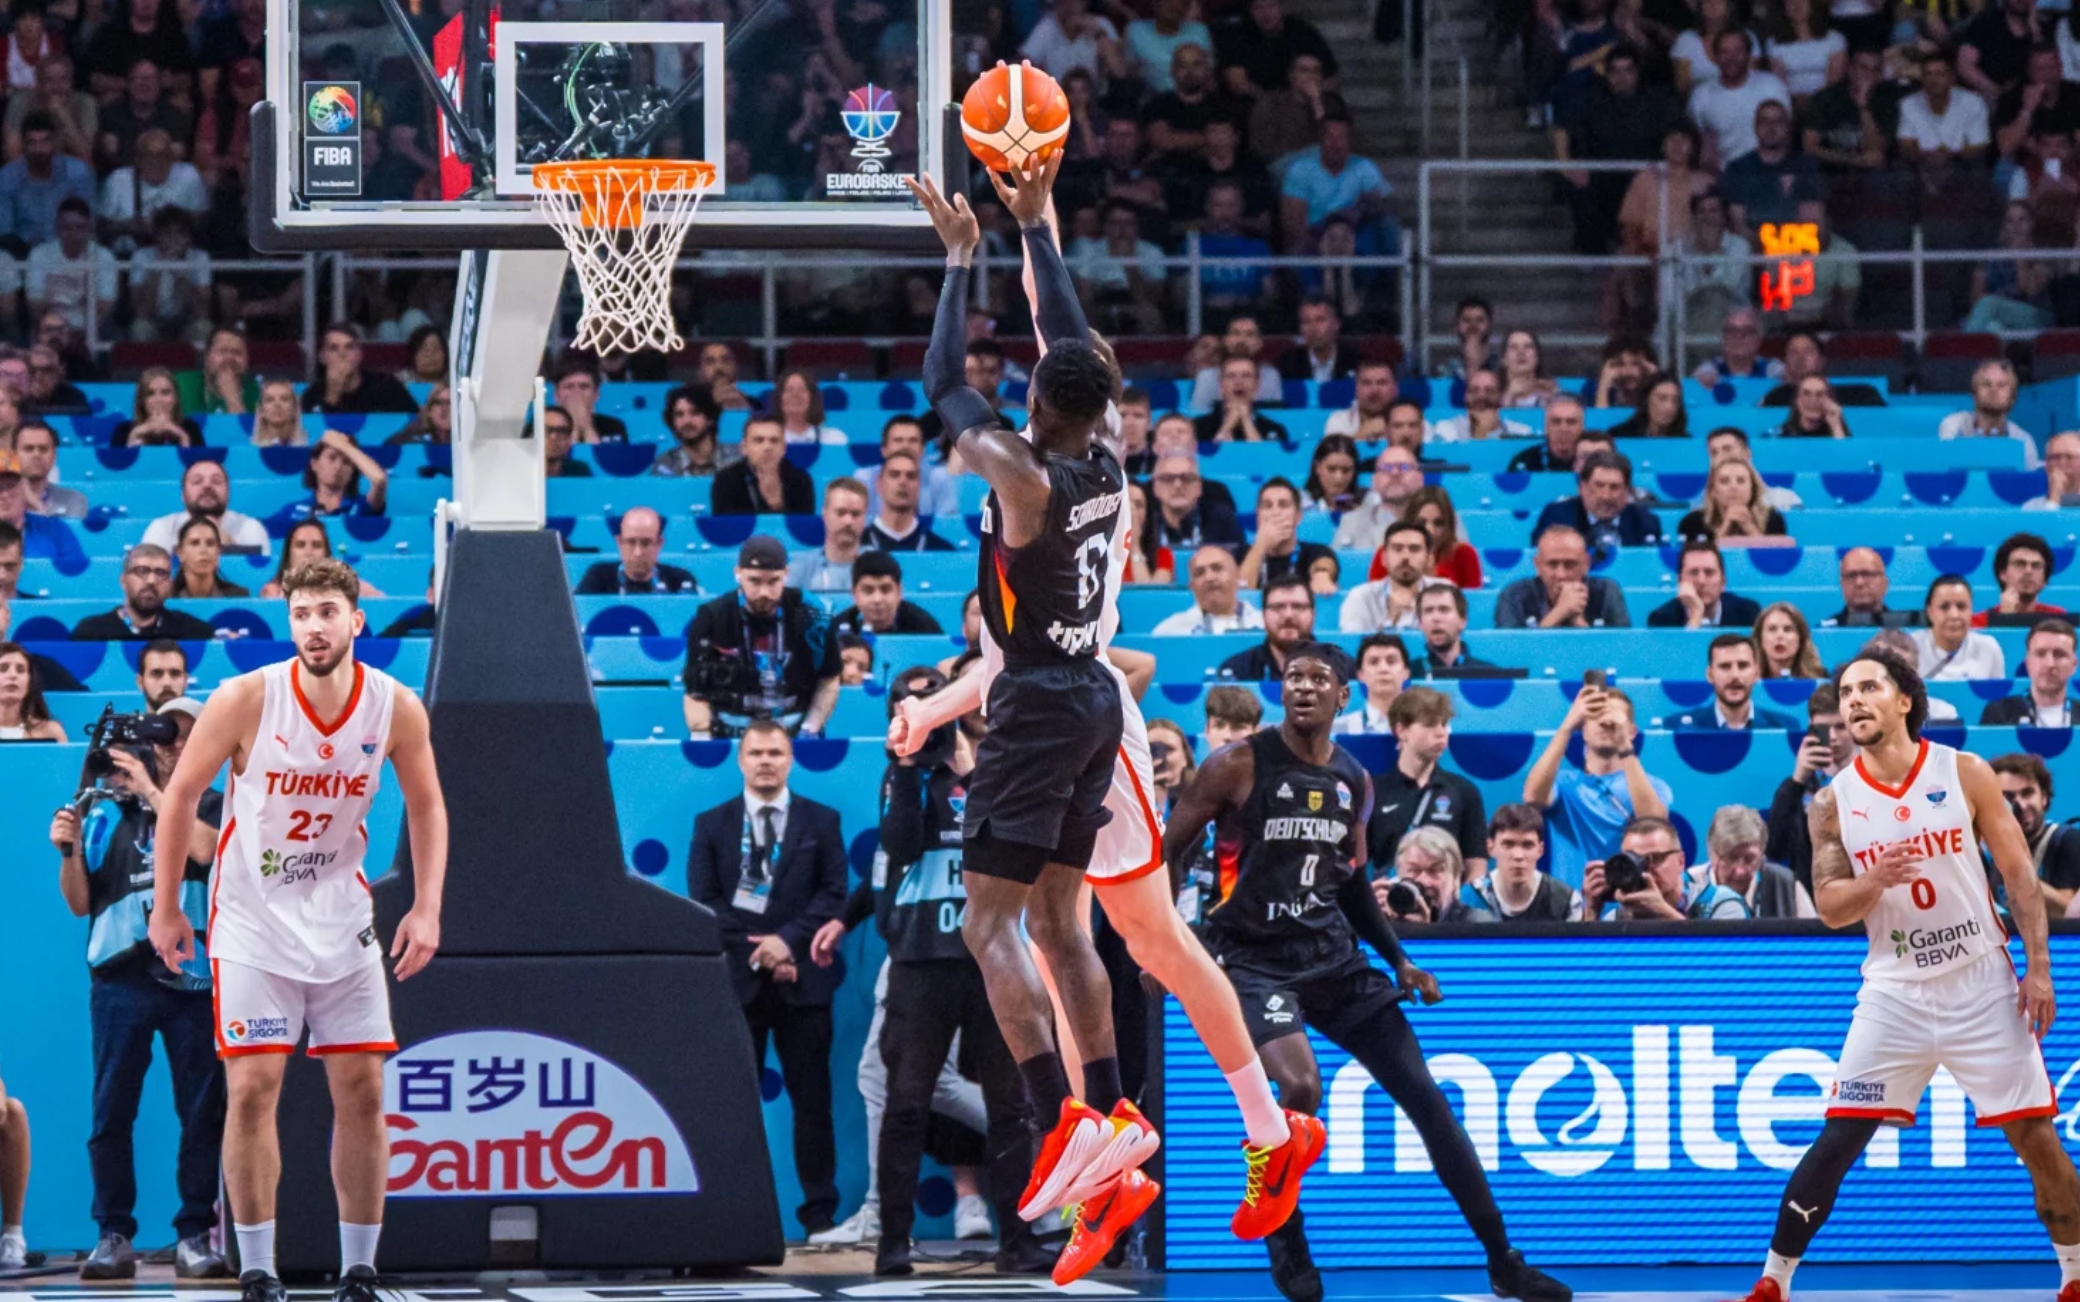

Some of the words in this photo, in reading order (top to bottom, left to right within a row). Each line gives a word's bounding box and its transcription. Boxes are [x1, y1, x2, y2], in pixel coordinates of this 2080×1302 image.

[313, 146, 352, 166] FIBA
[265, 768, 368, 798] TÜRKİYE
[285, 809, 333, 842] 23
[1300, 853, 1320, 887] 0
[1911, 877, 1937, 911] 0
[1908, 916, 1982, 950] Garanti
[1914, 942, 1970, 969] BBVA
[397, 1056, 595, 1114] 百岁山
